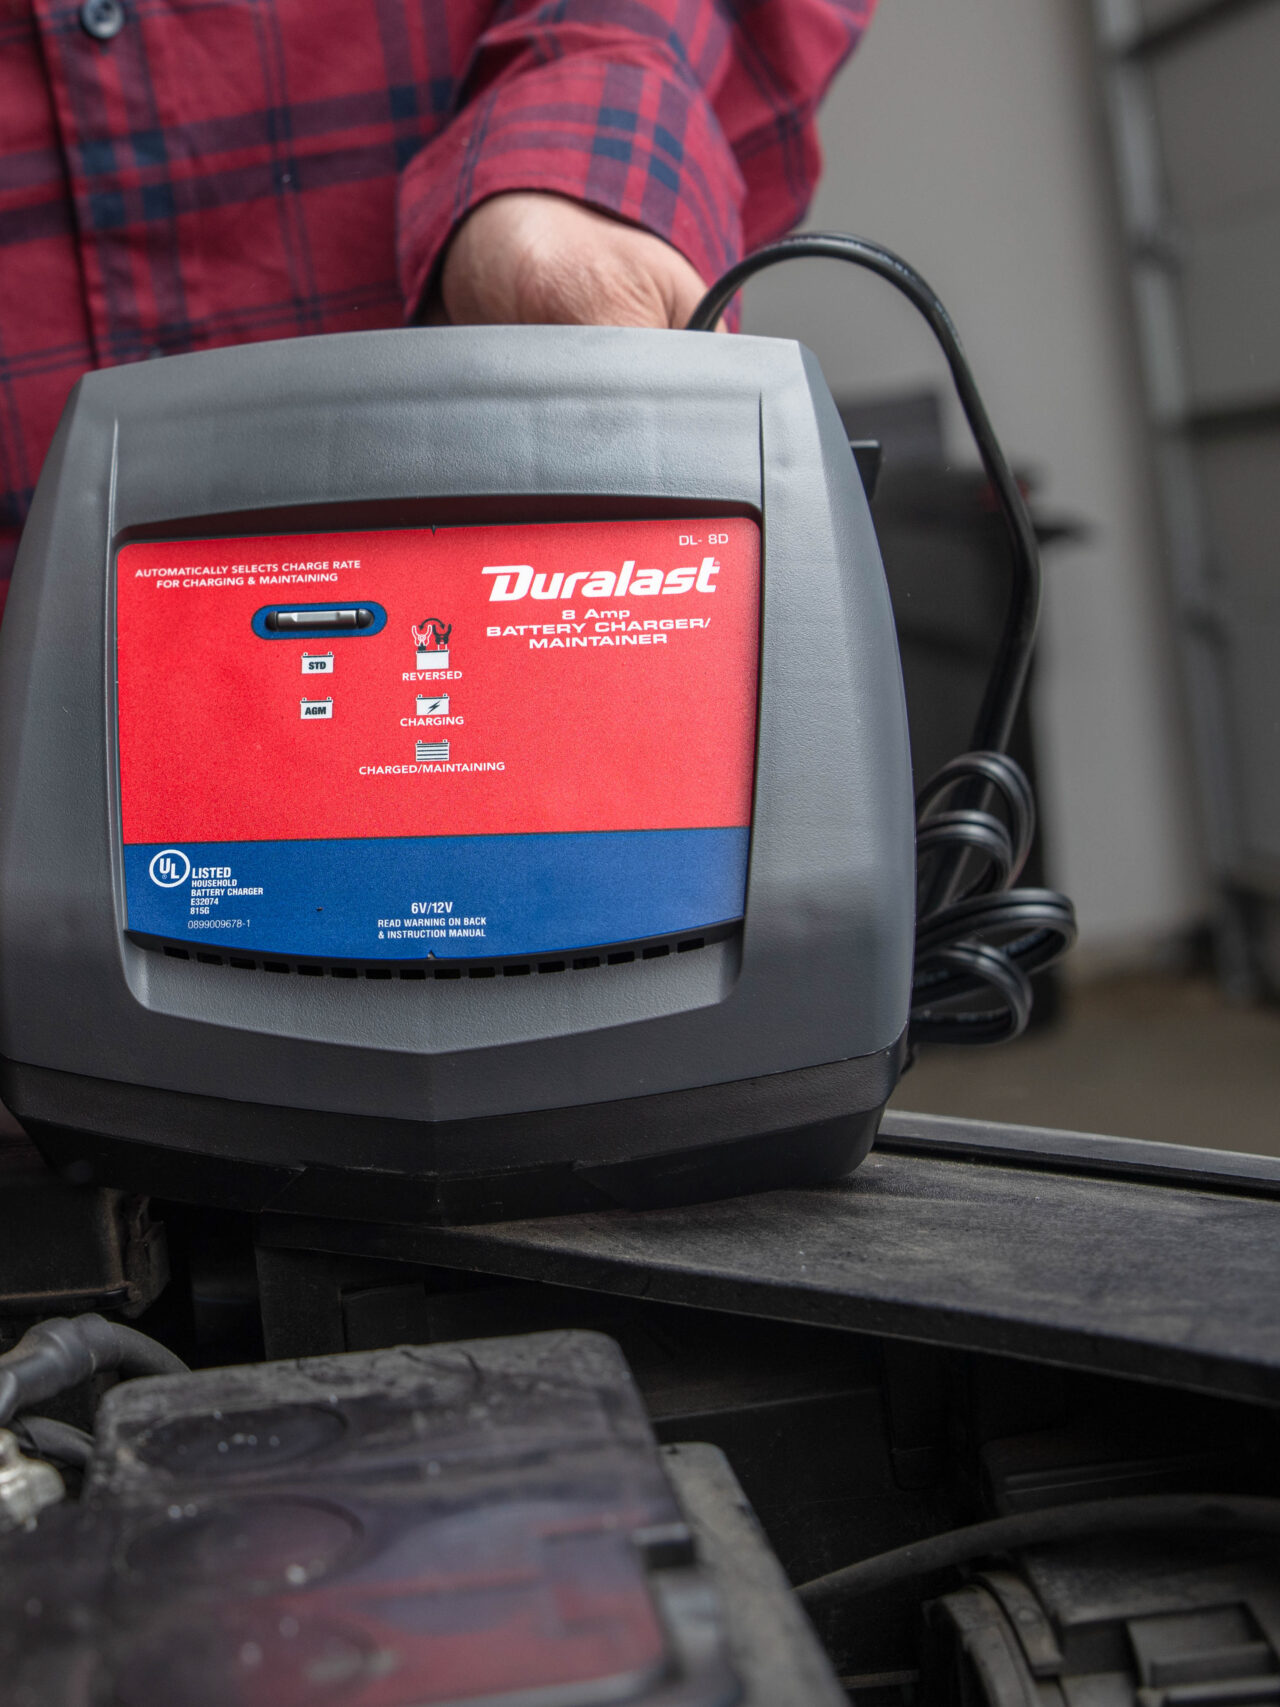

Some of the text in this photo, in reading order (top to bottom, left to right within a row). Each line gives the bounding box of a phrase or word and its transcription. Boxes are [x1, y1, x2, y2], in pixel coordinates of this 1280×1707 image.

[135, 560, 361, 578] AUTOMATICALLY SELECTS CHARGE RATE
[156, 572, 339, 588] FOR CHARGING & MAINTAINING
[481, 557, 721, 602] Duralast
[561, 608, 631, 620] 8 Amp
[486, 617, 712, 637] BATTERY CHARGER/
[529, 633, 668, 649] MAINTAINER
[308, 660, 327, 671] STD
[402, 671, 463, 681] REVERSED
[305, 706, 327, 716] AGM
[400, 716, 465, 727] CHARGING
[358, 762, 506, 775] CHARGED/MAINTAINING
[191, 867, 232, 879] LISTED
[191, 879, 238, 888] HOUSEHOLD
[191, 887, 264, 897] BATTERY CHARGER
[190, 898, 219, 906] E32074
[411, 902, 453, 915] 6V/12V
[377, 917, 487, 928] READ WARNING ON BACK
[378, 929, 486, 939] & INSTRUCTION MANUAL
